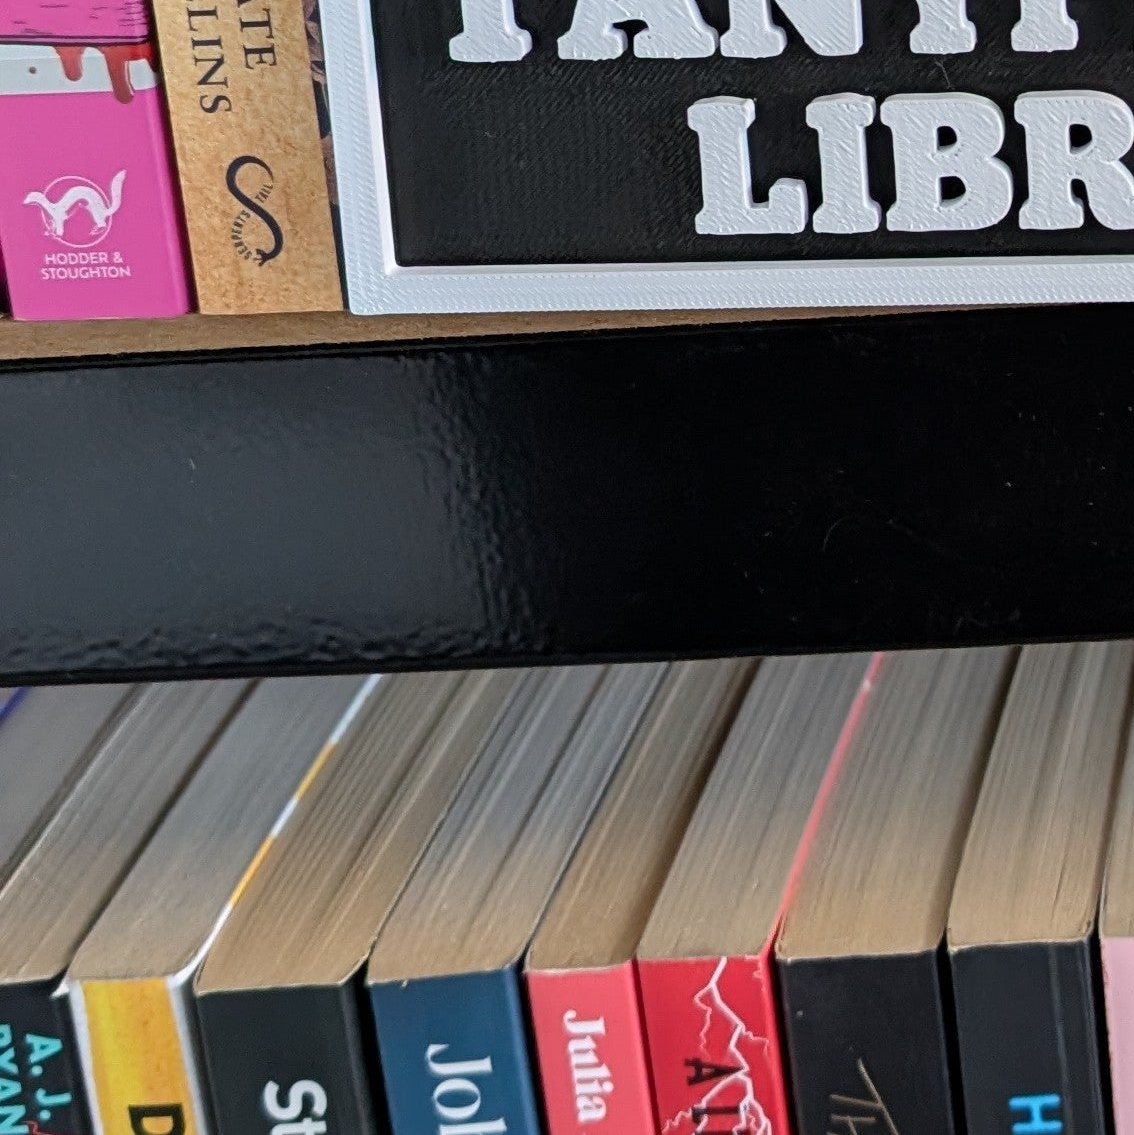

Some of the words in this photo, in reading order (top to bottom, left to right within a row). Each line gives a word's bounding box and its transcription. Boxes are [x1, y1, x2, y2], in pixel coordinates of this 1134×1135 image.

[45, 252, 108, 265] HODDER
[113, 251, 124, 264] &
[41, 266, 131, 280] STOUGHTON
[563, 1009, 613, 1123] Julia
